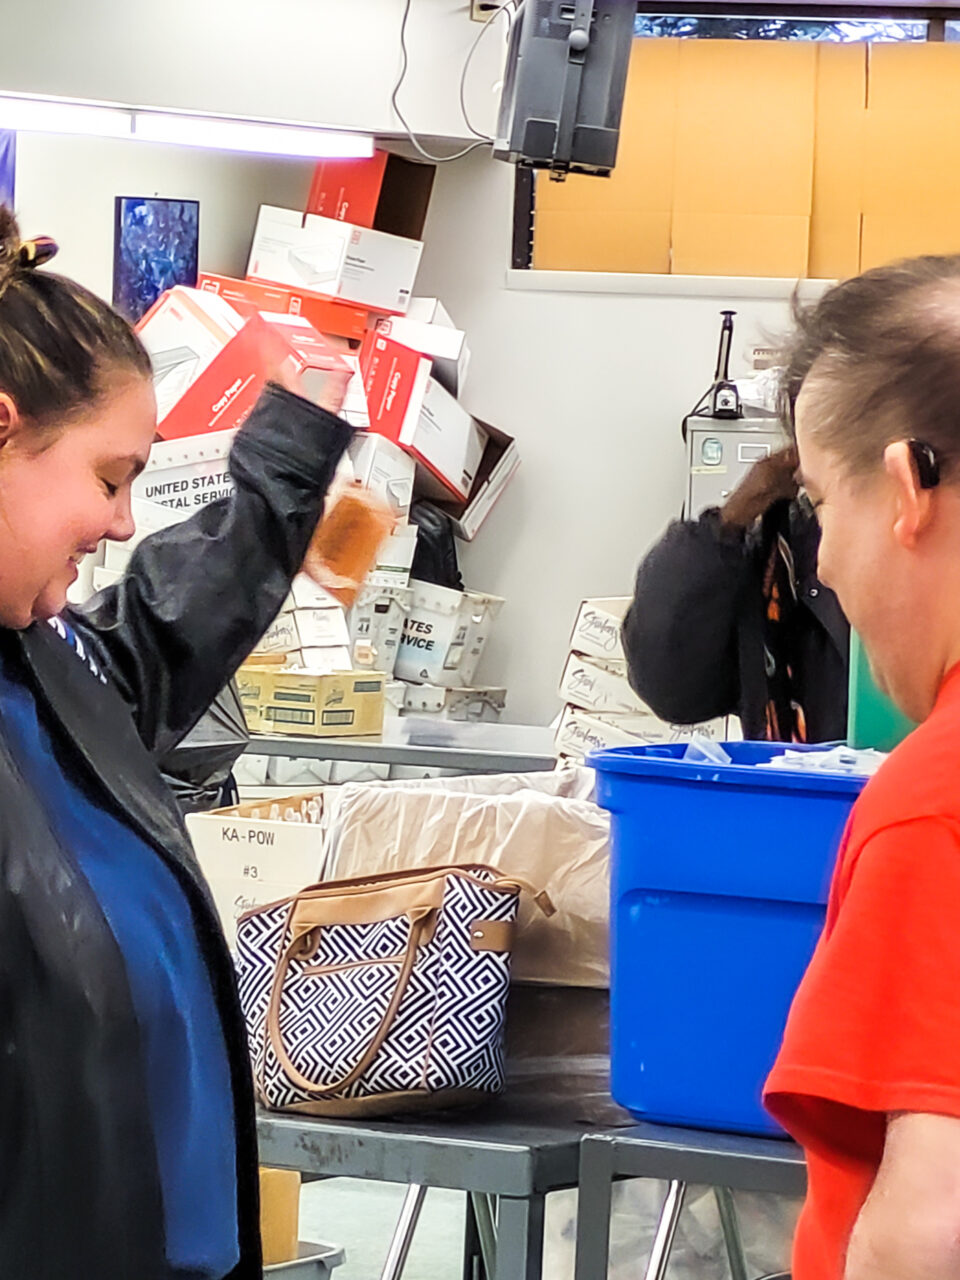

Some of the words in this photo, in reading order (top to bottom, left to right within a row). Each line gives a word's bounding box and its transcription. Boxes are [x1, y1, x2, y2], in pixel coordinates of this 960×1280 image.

[145, 480, 189, 498] UNITED
[191, 471, 231, 490] STATE
[243, 866, 258, 879] #3
